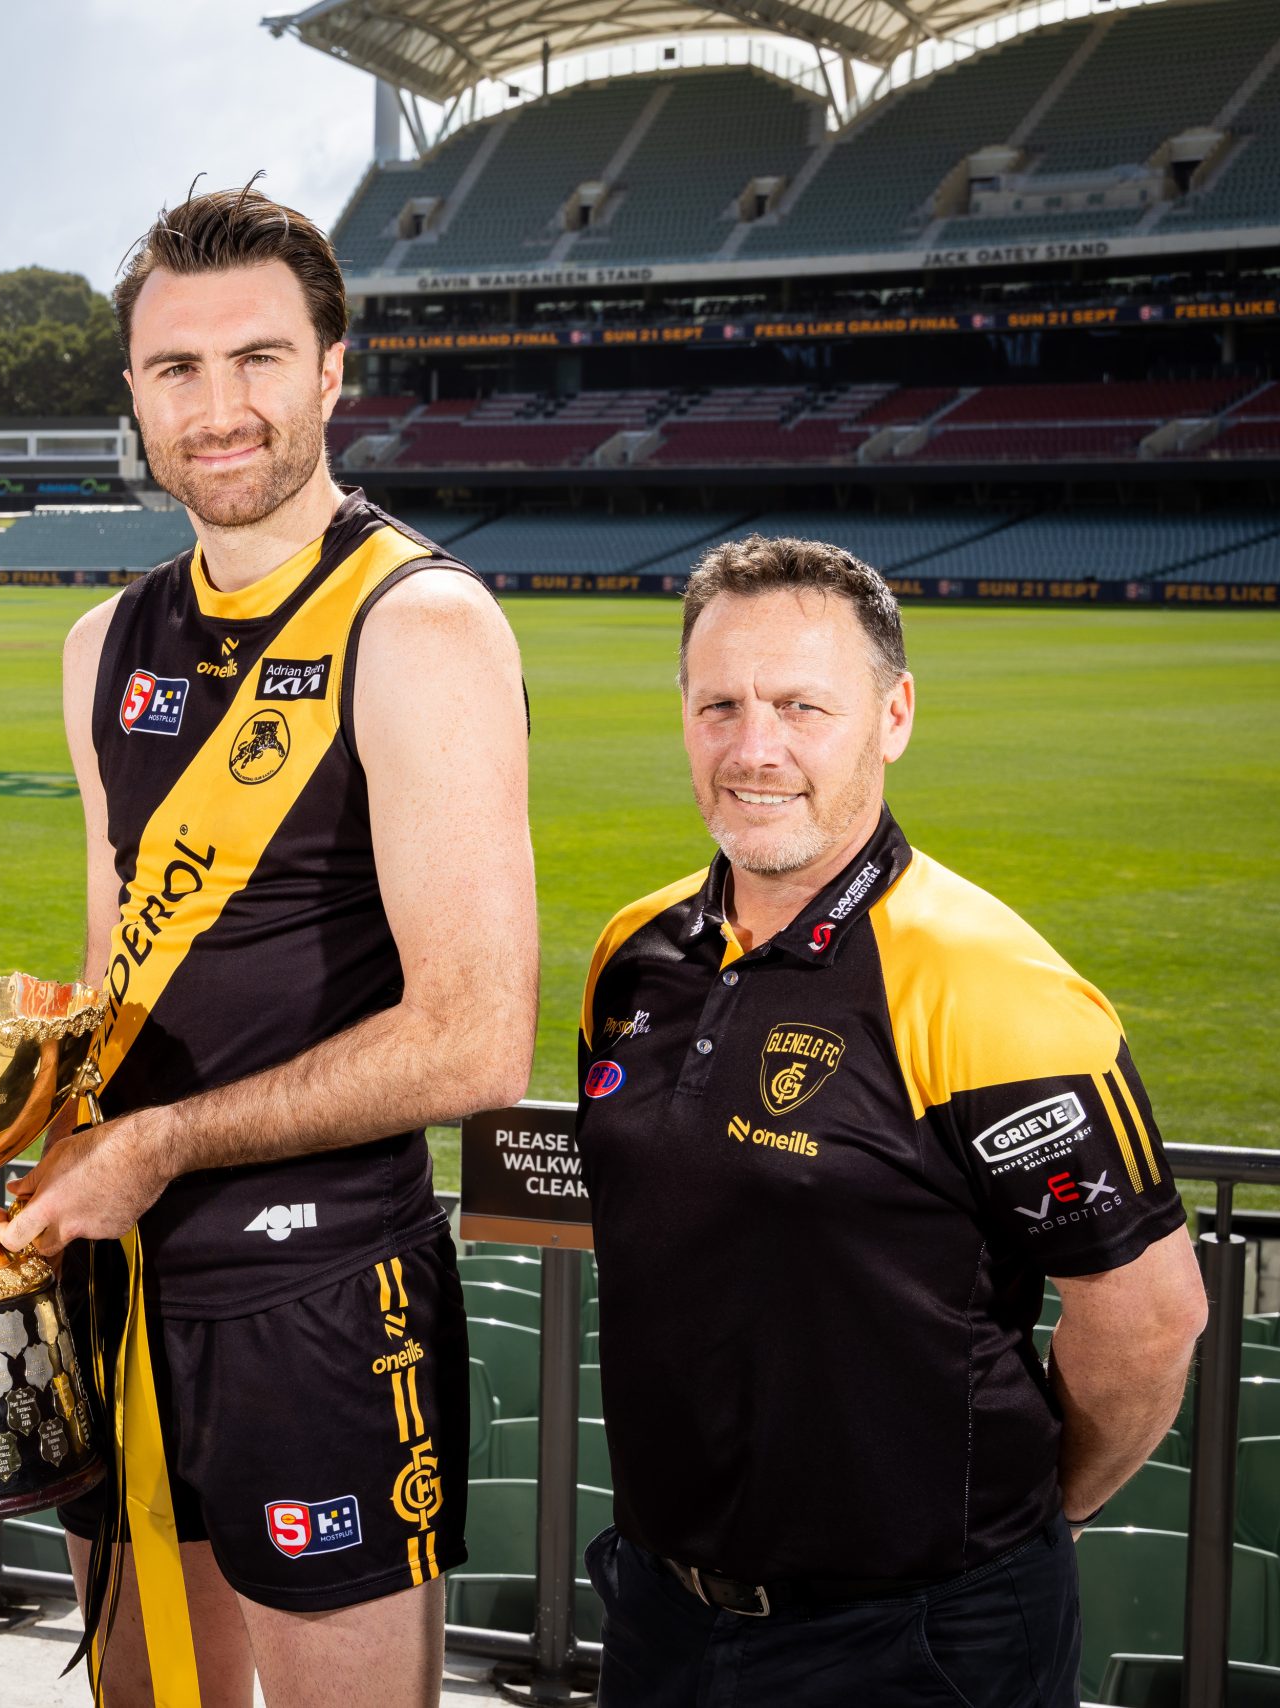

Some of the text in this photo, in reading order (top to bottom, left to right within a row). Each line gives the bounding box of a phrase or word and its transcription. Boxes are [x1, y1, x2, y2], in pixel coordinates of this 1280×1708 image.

[1045, 242, 1110, 259] STAND
[596, 268, 653, 283] STAND
[1008, 309, 1118, 327] SUN 21 SEPT
[603, 329, 637, 343] SUN
[662, 327, 704, 341] SEPT
[266, 663, 301, 677] Adrian
[148, 714, 177, 724] HOSTPLUS
[828, 861, 875, 919] DAVISON
[766, 1032, 840, 1068] GLENELG FC
[993, 1105, 1069, 1150] GRIEVE
[496, 1129, 569, 1153] PLEASE
[991, 1149, 1040, 1176] PROPERTY
[1054, 1126, 1092, 1150] PROJECT
[502, 1152, 583, 1176] WALKW
[1023, 1148, 1073, 1171] SOLUTIONS
[1013, 1169, 1117, 1220] VEX
[1028, 1194, 1123, 1236] ROBOTICS
[320, 1528, 353, 1542] HOSTPLUS
